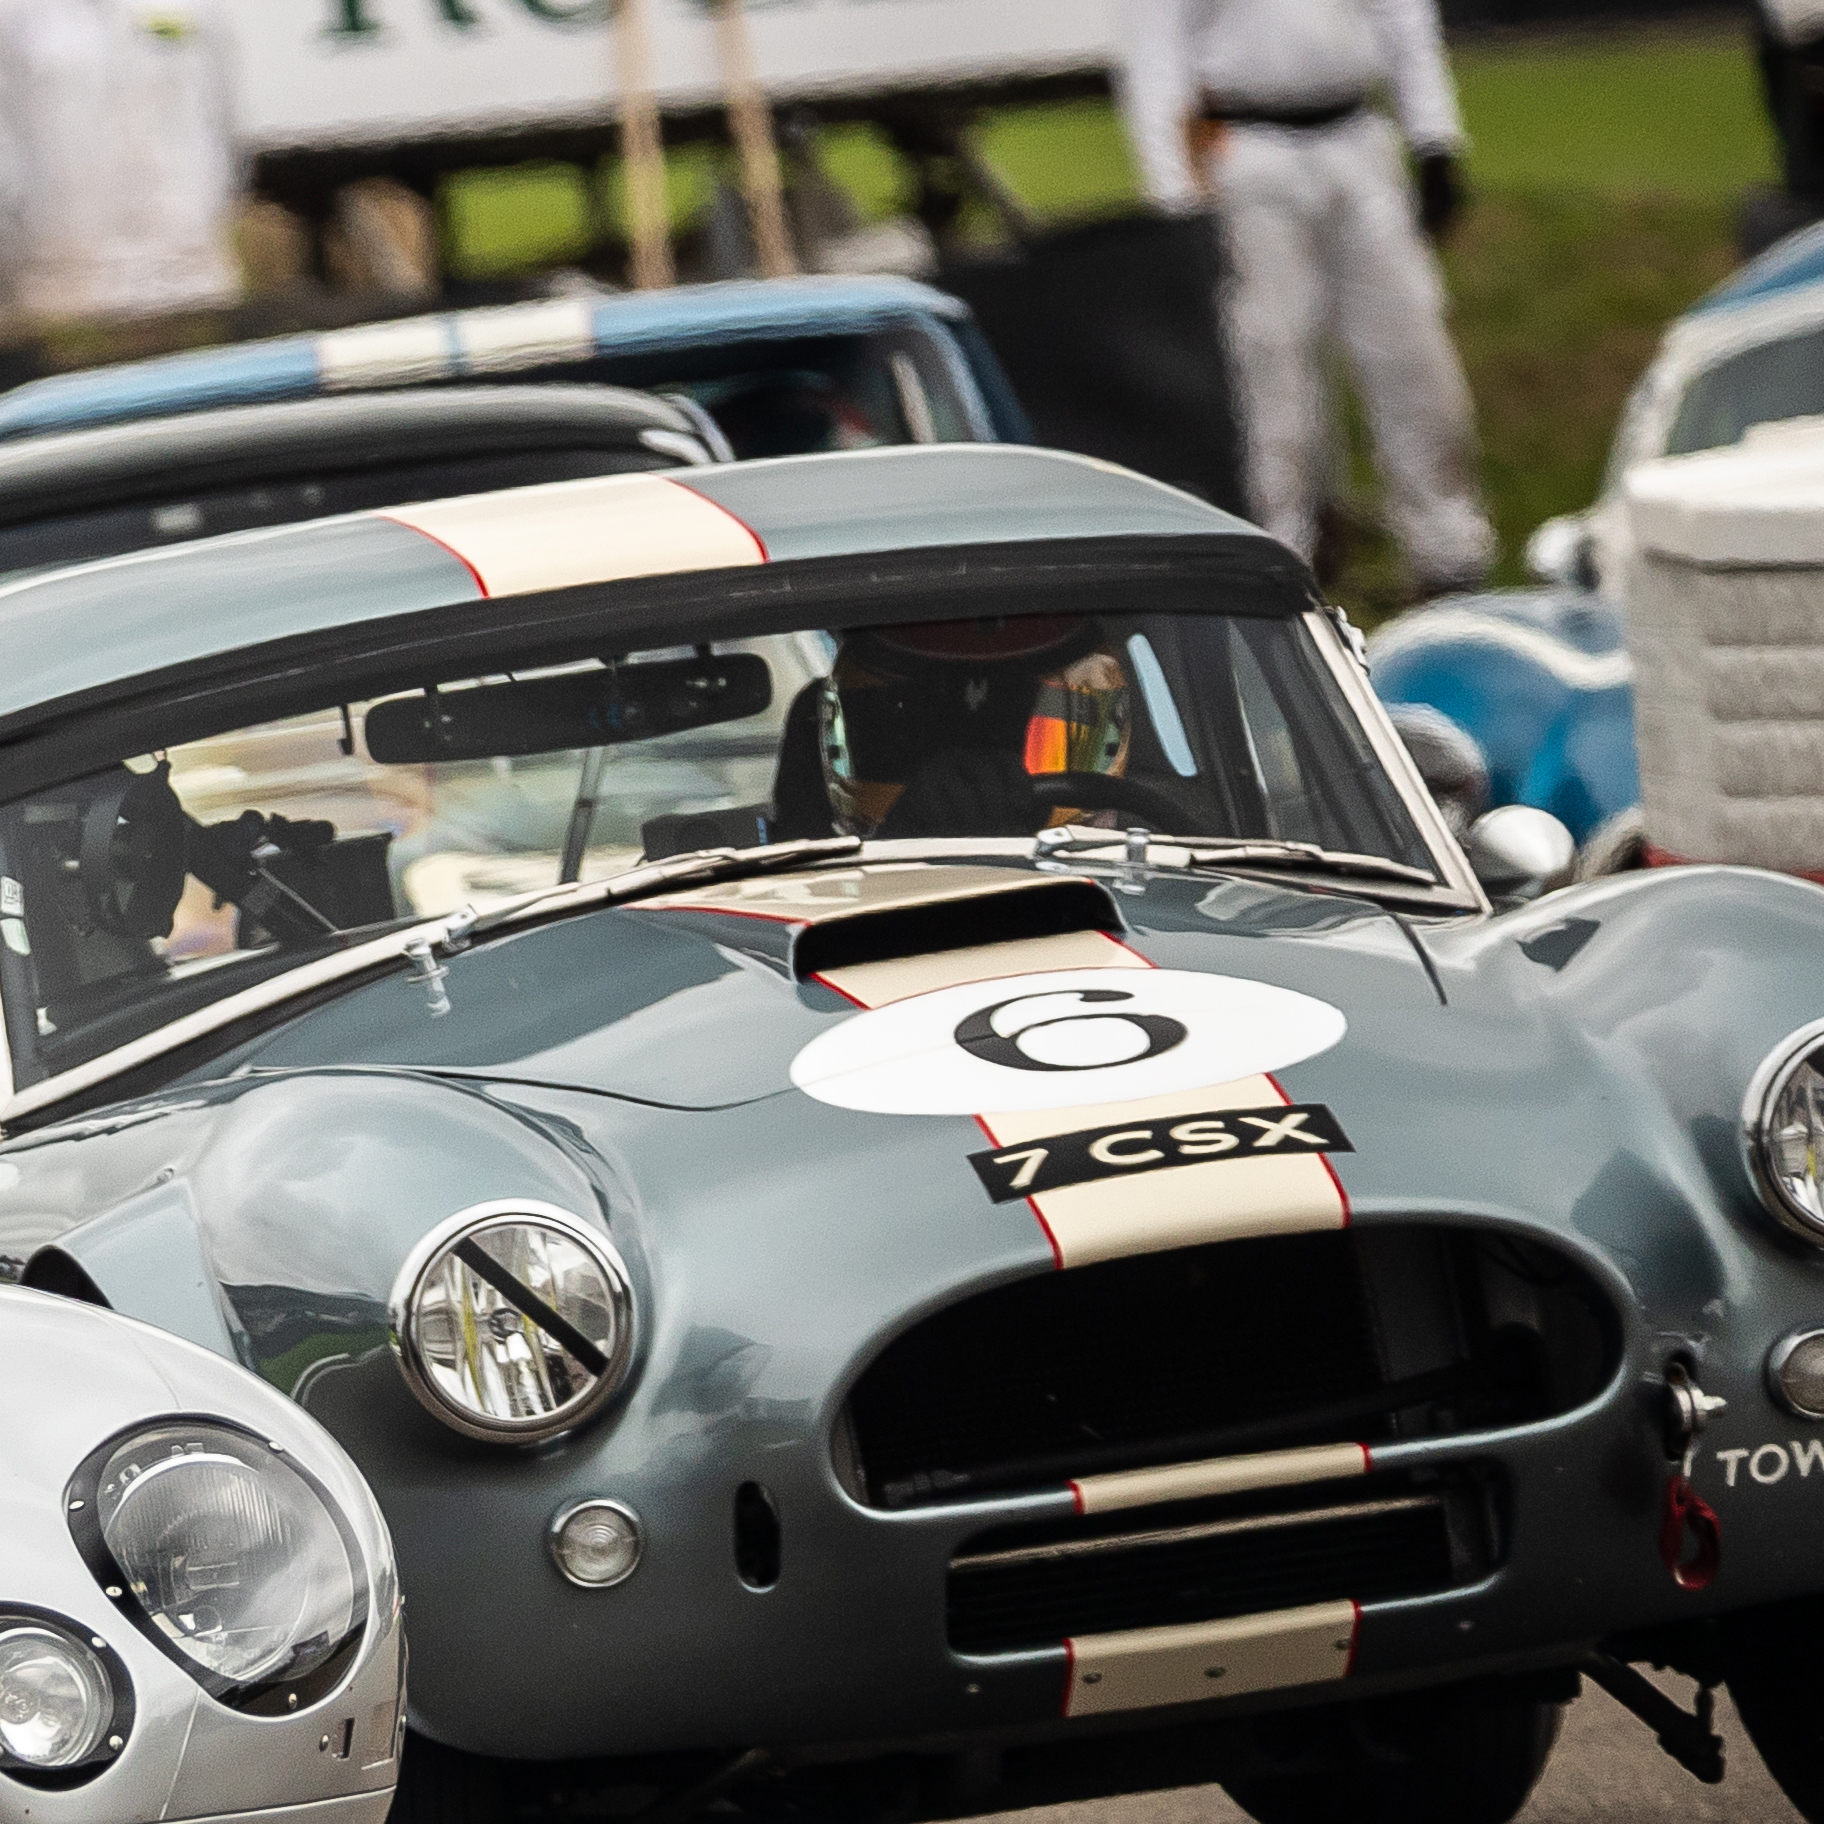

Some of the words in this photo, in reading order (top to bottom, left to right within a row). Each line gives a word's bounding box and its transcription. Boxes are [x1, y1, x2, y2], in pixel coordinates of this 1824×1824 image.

[954, 989, 1189, 1072] 6
[993, 1148, 1049, 1189] 7
[1088, 1112, 1330, 1165] CSX
[1715, 1439, 1824, 1487] TOW
